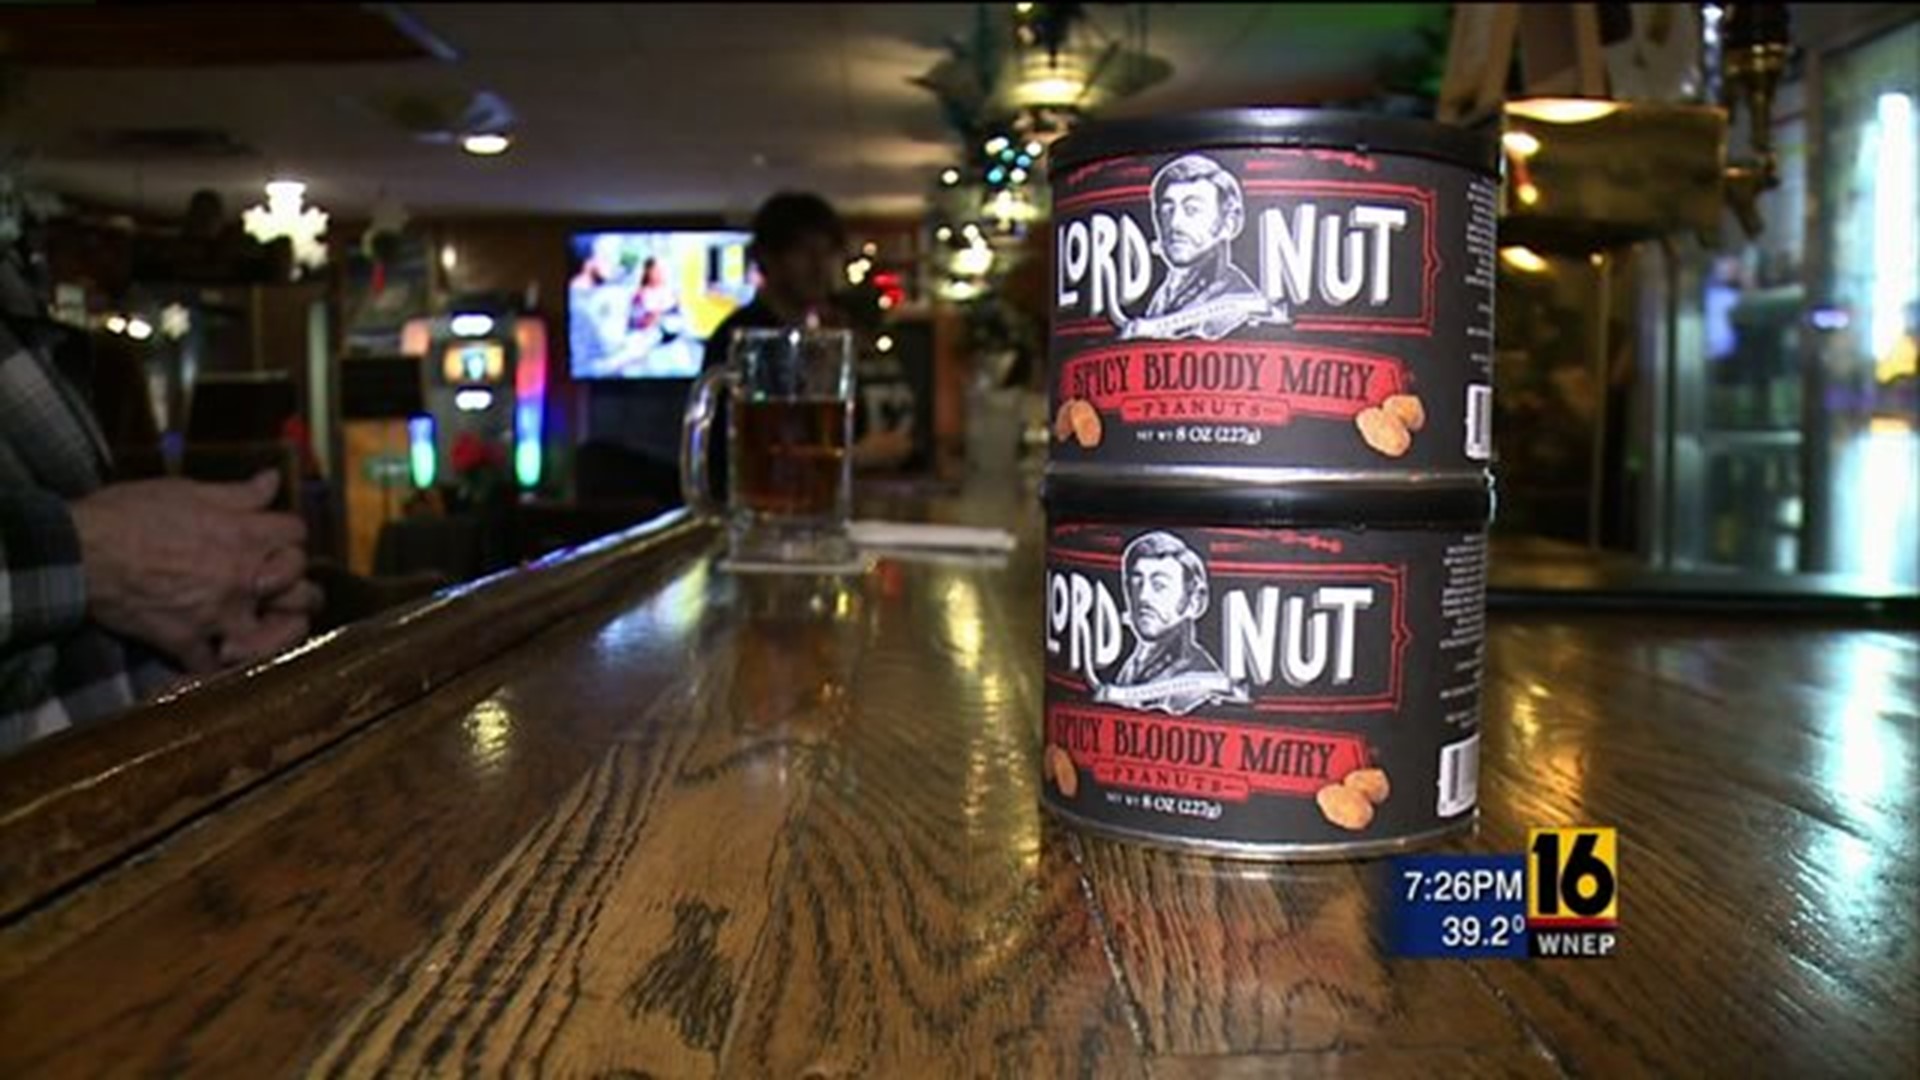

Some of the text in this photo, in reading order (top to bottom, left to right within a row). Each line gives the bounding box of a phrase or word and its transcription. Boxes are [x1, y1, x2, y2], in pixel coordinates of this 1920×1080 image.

[1057, 213, 1153, 326] LORD
[1259, 203, 1407, 306] NUT
[1073, 351, 1375, 402] SPICY BLOODY MARY
[1142, 400, 1261, 416] PEANUTS
[1188, 426, 1213, 443] OZ
[1047, 569, 1123, 688] LORD
[1221, 586, 1374, 686] NUT
[1055, 712, 1337, 779] SPICY BLOODY MARY
[1111, 766, 1222, 792] PEANUTS
